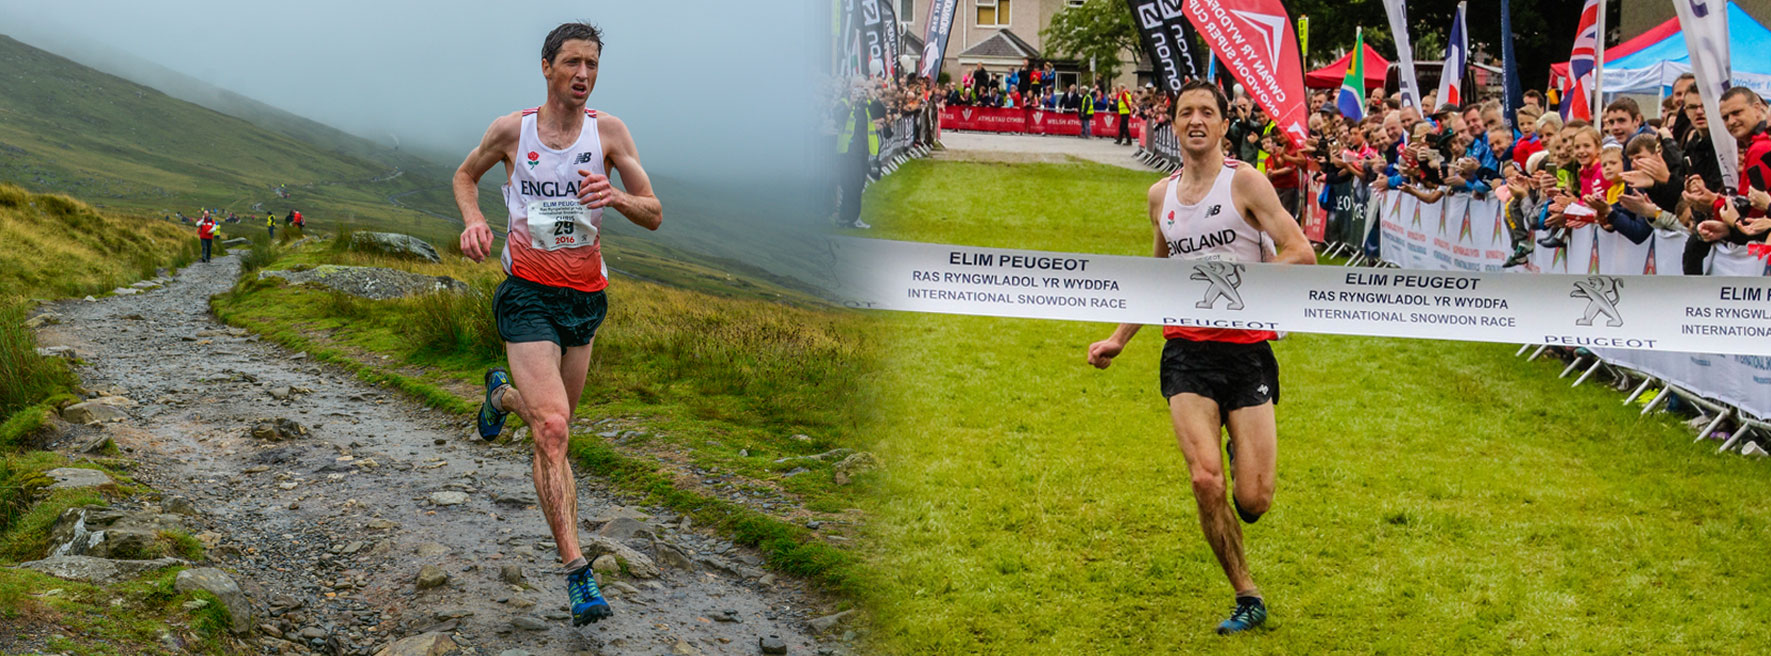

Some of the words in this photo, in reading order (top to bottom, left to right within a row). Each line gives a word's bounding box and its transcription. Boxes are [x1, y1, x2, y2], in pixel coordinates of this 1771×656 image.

[521, 180, 582, 197] ENGLA
[554, 221, 574, 236] 29
[555, 236, 575, 244] 2016
[949, 252, 993, 267] ELIM
[999, 255, 1089, 271] PEUGEOT
[912, 270, 940, 282] RAS
[944, 272, 1038, 288] RYNGWLADOL
[1042, 277, 1060, 288] YR
[1063, 278, 1120, 291] WYDDFA
[1345, 272, 1388, 286] ELIM
[1393, 275, 1481, 290] PEUGEOT
[907, 288, 1014, 304] INTERNATIONAL
[1018, 293, 1087, 307] SNOWDON
[1090, 297, 1127, 309] RACE
[1309, 290, 1336, 301] RAS
[1339, 291, 1430, 306] RYNGWLADOL
[1434, 296, 1451, 307] YR
[1454, 297, 1509, 310] WYDDFA
[1720, 286, 1761, 301] ELIM
[1304, 307, 1407, 323] INTERNATIONAL
[1410, 312, 1477, 326] SNOWDON
[1480, 316, 1516, 327] RACE
[1685, 307, 1712, 318] RAS
[1715, 308, 1771, 320] RYNGWL
[1163, 317, 1279, 329] PEUGEOT
[1544, 335, 1657, 348] PEUGEOT
